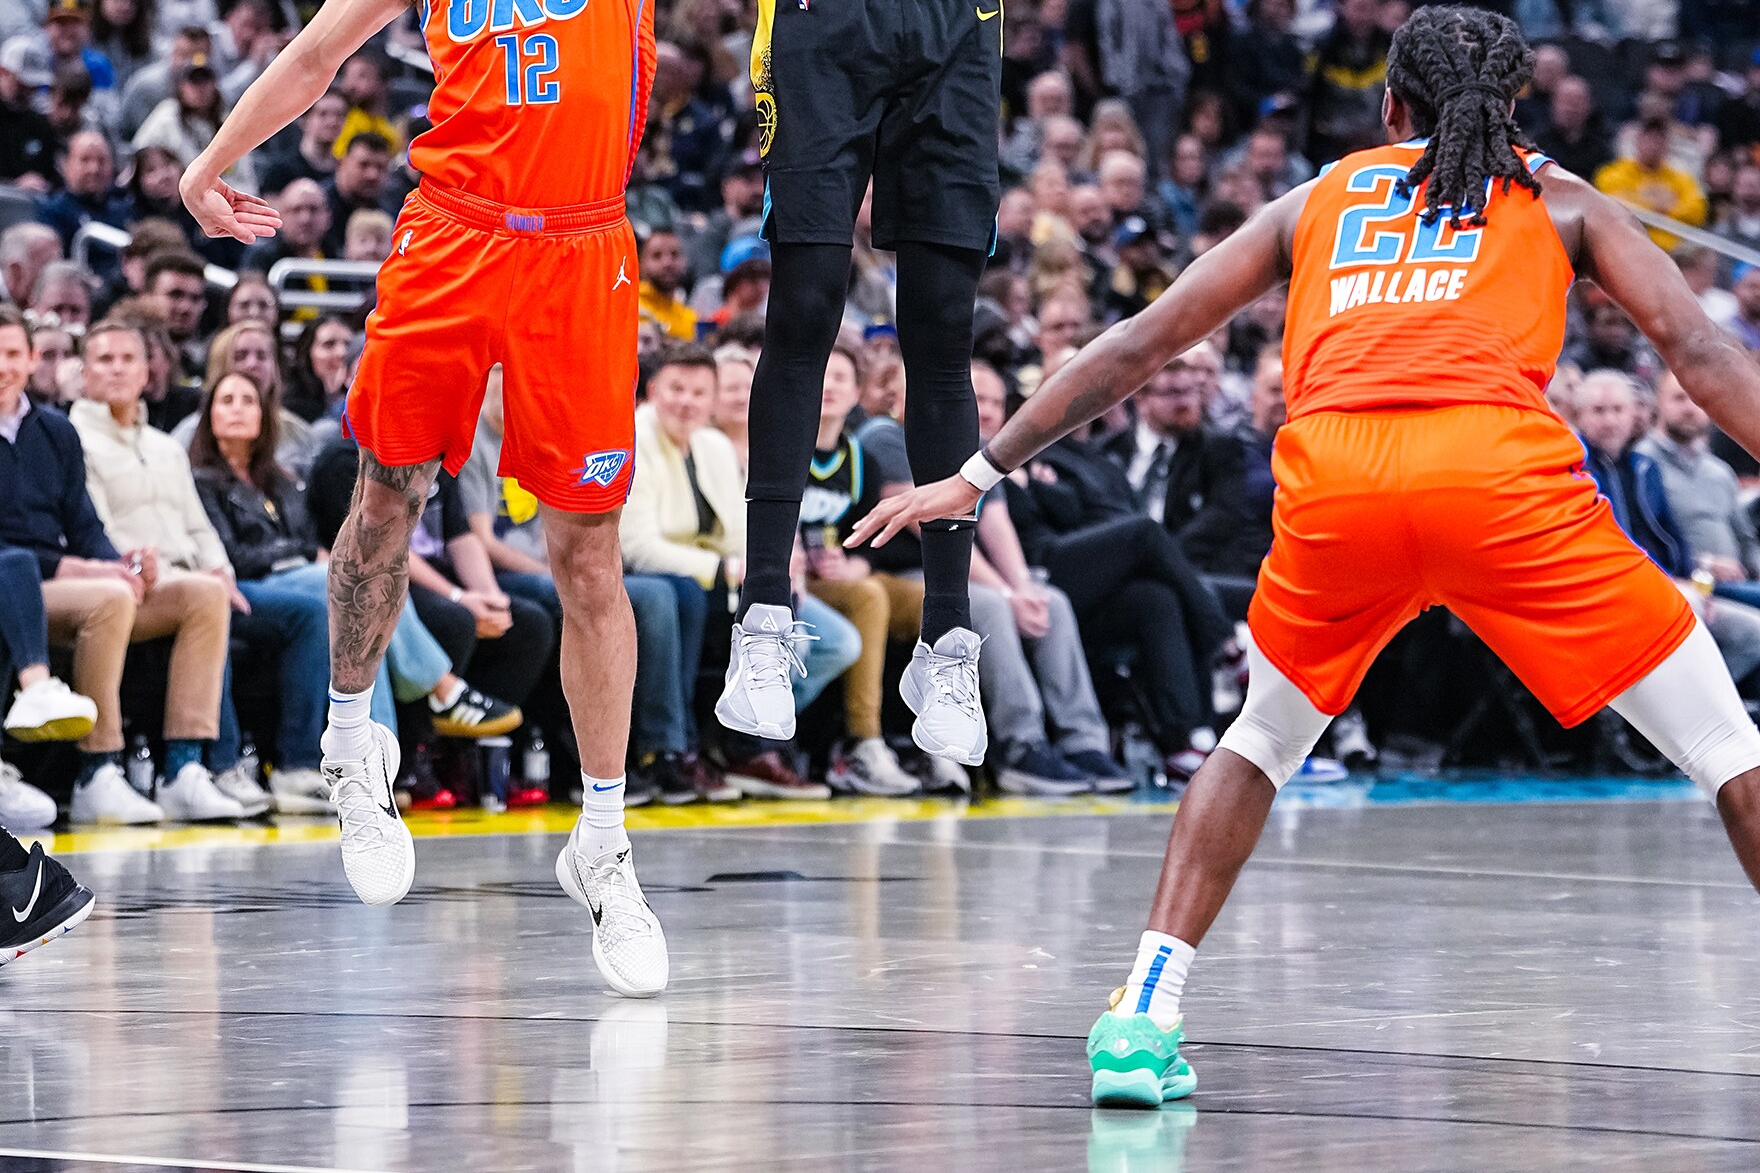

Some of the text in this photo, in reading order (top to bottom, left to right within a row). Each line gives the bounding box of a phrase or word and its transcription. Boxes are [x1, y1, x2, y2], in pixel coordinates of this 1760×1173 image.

[495, 33, 560, 106] 12
[505, 212, 543, 232] THUNDER
[1329, 269, 1468, 318] WALLACE
[582, 455, 620, 480] OKC
